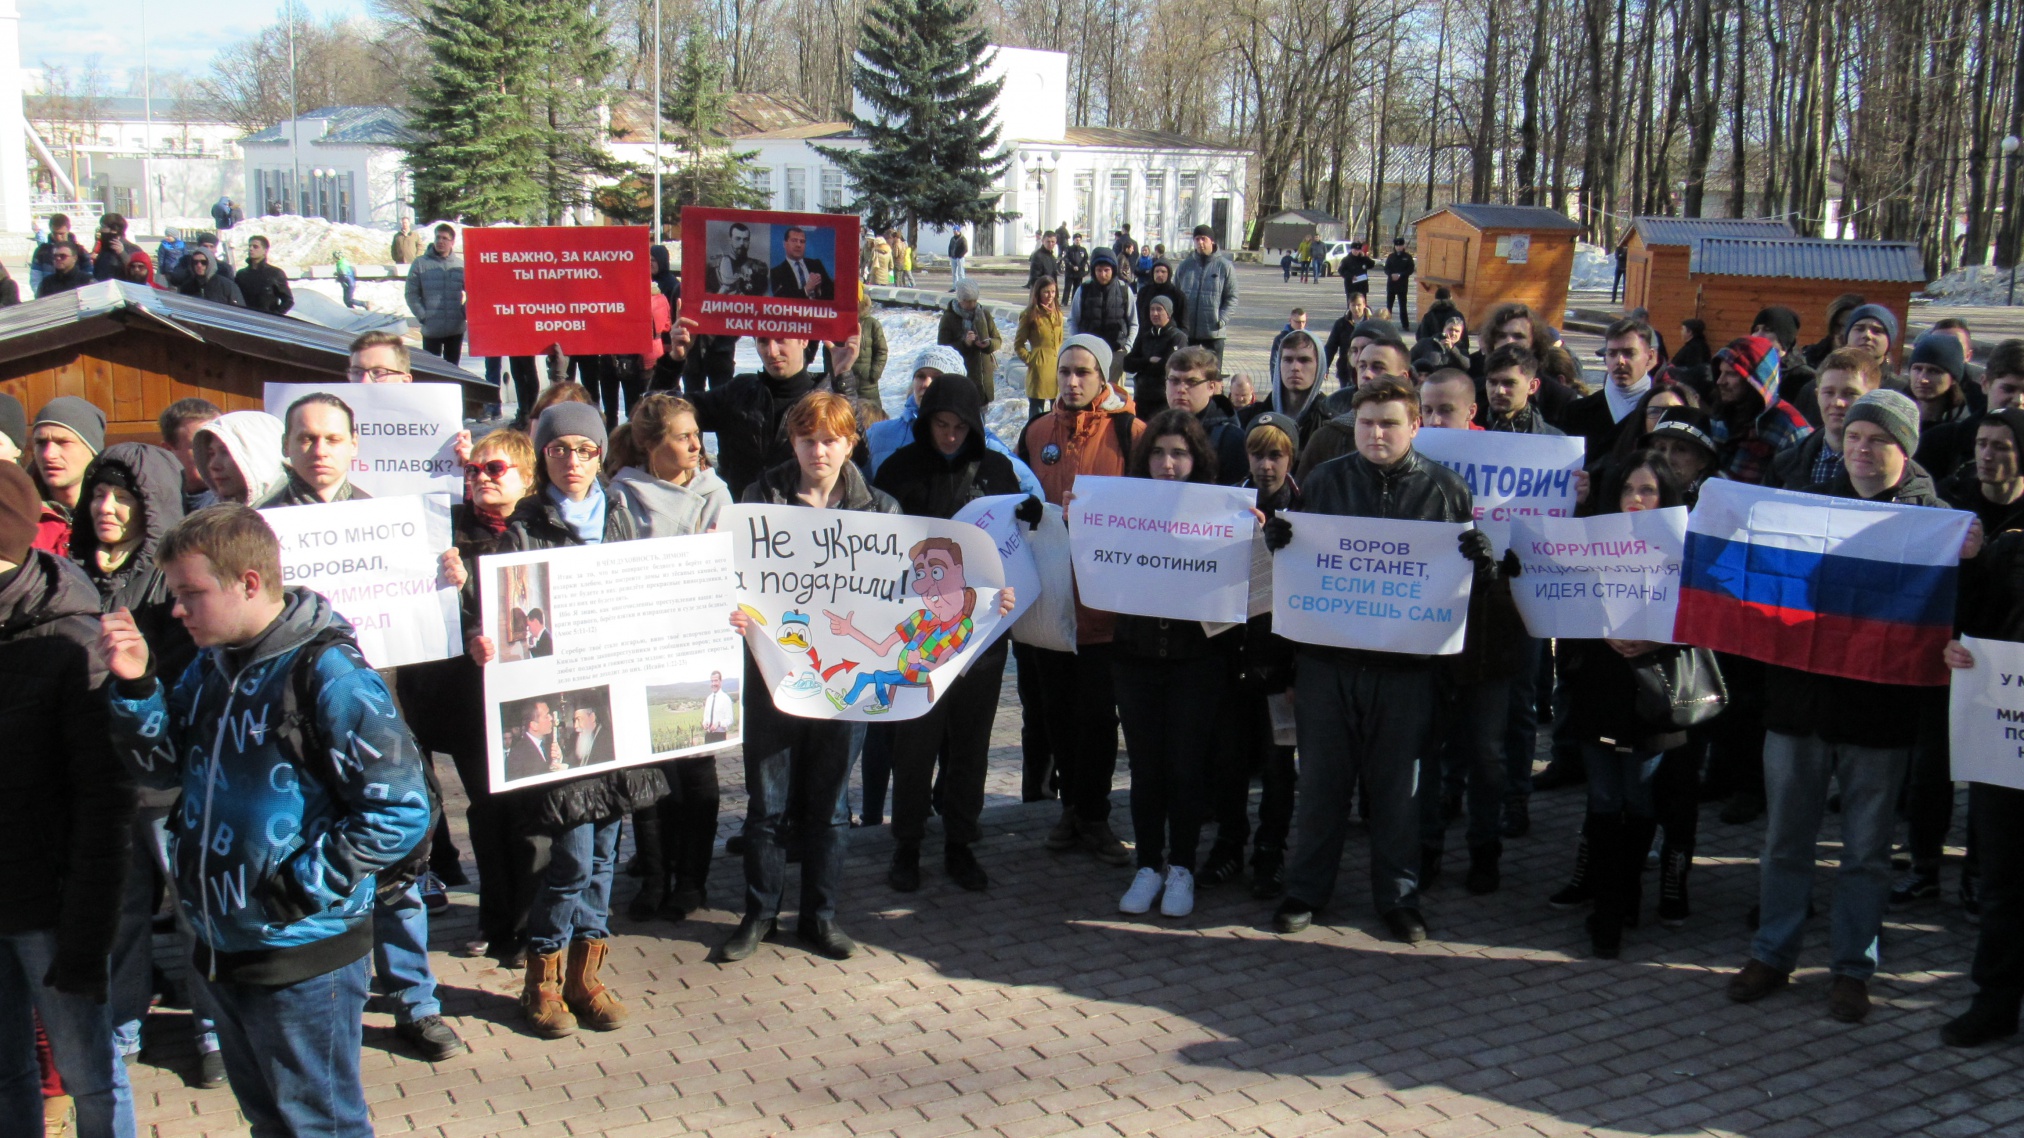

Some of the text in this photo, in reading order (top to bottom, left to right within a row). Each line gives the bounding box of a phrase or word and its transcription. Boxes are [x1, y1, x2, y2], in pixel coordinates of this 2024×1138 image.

[480, 250, 634, 265] НЕ ВАЖНО, ЗА КАКУЮ
[513, 268, 602, 280] ТЫ ПАРТИЮ.
[493, 303, 625, 315] ТЫ ТОЧНО ПРОТИВ
[701, 300, 838, 319] ДИМОН, КОНЧИШЬ
[535, 320, 586, 332] ВОРОВ!
[725, 318, 813, 334] КАК КОЛЯН!
[375, 459, 454, 473] ПЛАВОК?
[1437, 461, 1571, 497] АТОВИЧ
[1083, 512, 1234, 538] НЕ РАСКАЧИВАЙТЕ
[299, 530, 338, 550] КТО
[345, 522, 415, 544] МНОГО
[749, 516, 904, 571] Не украл,
[1340, 538, 1410, 556] ВОРОВ
[1532, 540, 1647, 558] КОРРУПЦИЯ
[283, 555, 389, 582] ВОРОВАЛ,
[1093, 549, 1217, 573] ЯХТУ ФОТИНИЯ
[1316, 553, 1430, 580] НЕ СТАНЕТ,
[1523, 563, 1680, 576] НАЦИОНАЛЬНАЯ
[321, 575, 439, 604] ИМИРСКИЙ
[760, 570, 910, 605] подарили!
[1321, 575, 1422, 599] ЕСЛИ ВСЁ
[1536, 582, 1667, 601] ИДЕЯ СТРАНЫ
[1288, 594, 1452, 622] СВОРУЕШЬ САМ
[353, 613, 392, 631] РАЛ
[2001, 673, 2012, 686] У
[1997, 708, 2024, 723] МИ
